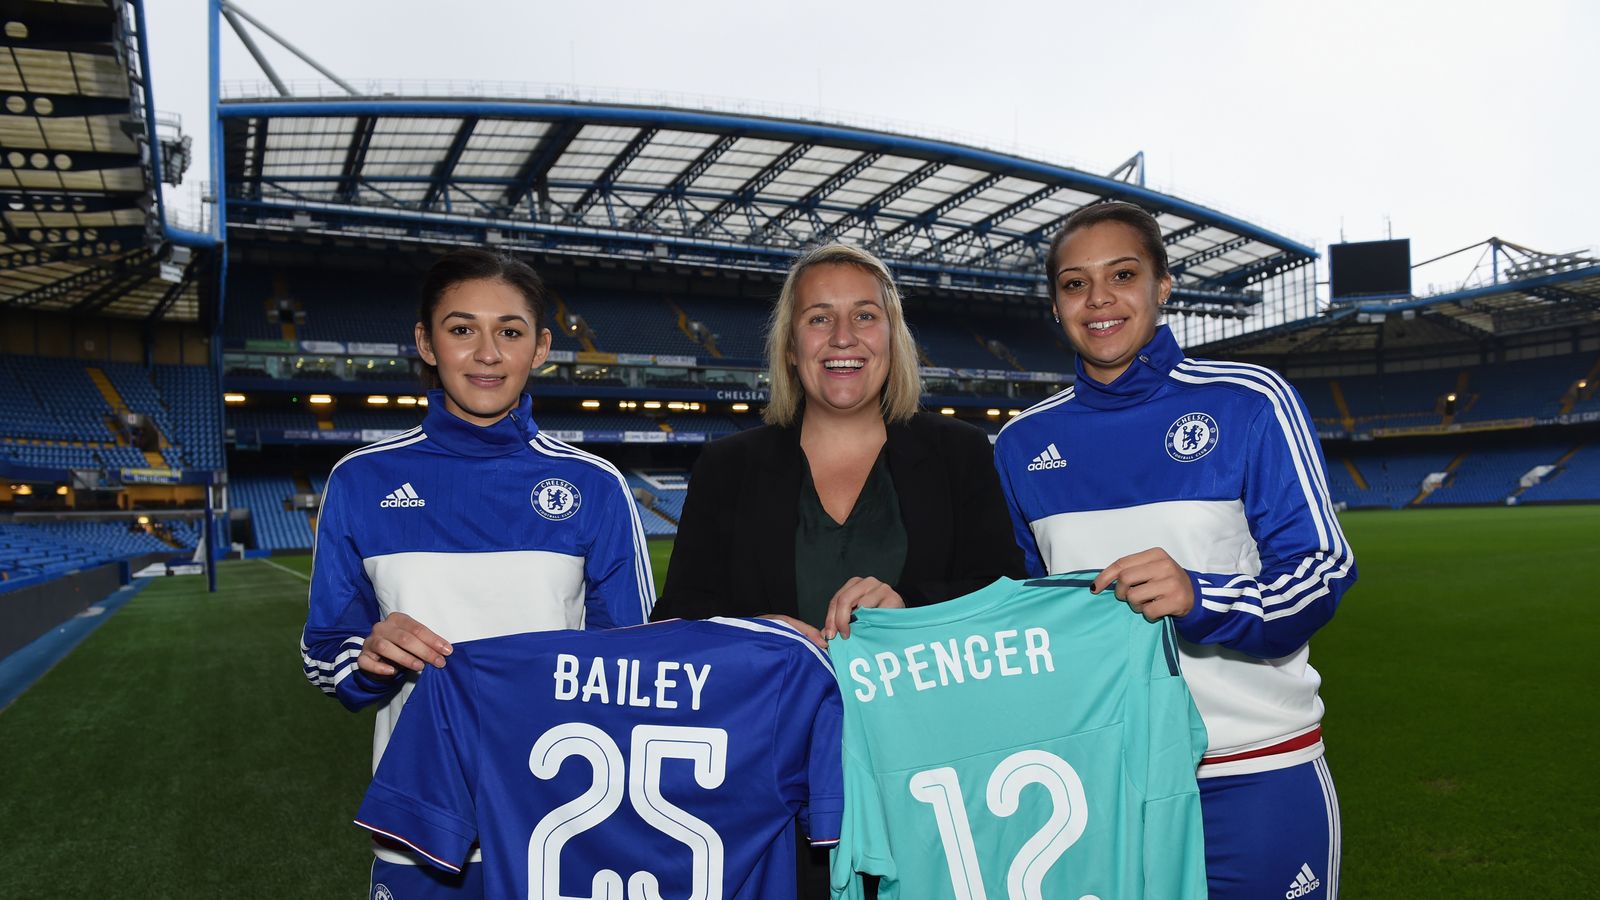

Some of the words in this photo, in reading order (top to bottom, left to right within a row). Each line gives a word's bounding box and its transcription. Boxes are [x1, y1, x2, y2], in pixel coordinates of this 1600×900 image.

[716, 390, 765, 400] CHELSEA
[1176, 414, 1209, 427] CHELSEA
[1027, 459, 1067, 471] adidas
[540, 480, 573, 490] CHELSEA
[380, 498, 426, 508] adidas
[849, 626, 1056, 703] SPENCER
[553, 653, 712, 711] BAILEY
[527, 722, 729, 900] 25
[909, 749, 1101, 900] 12
[1285, 878, 1320, 900] adidas
